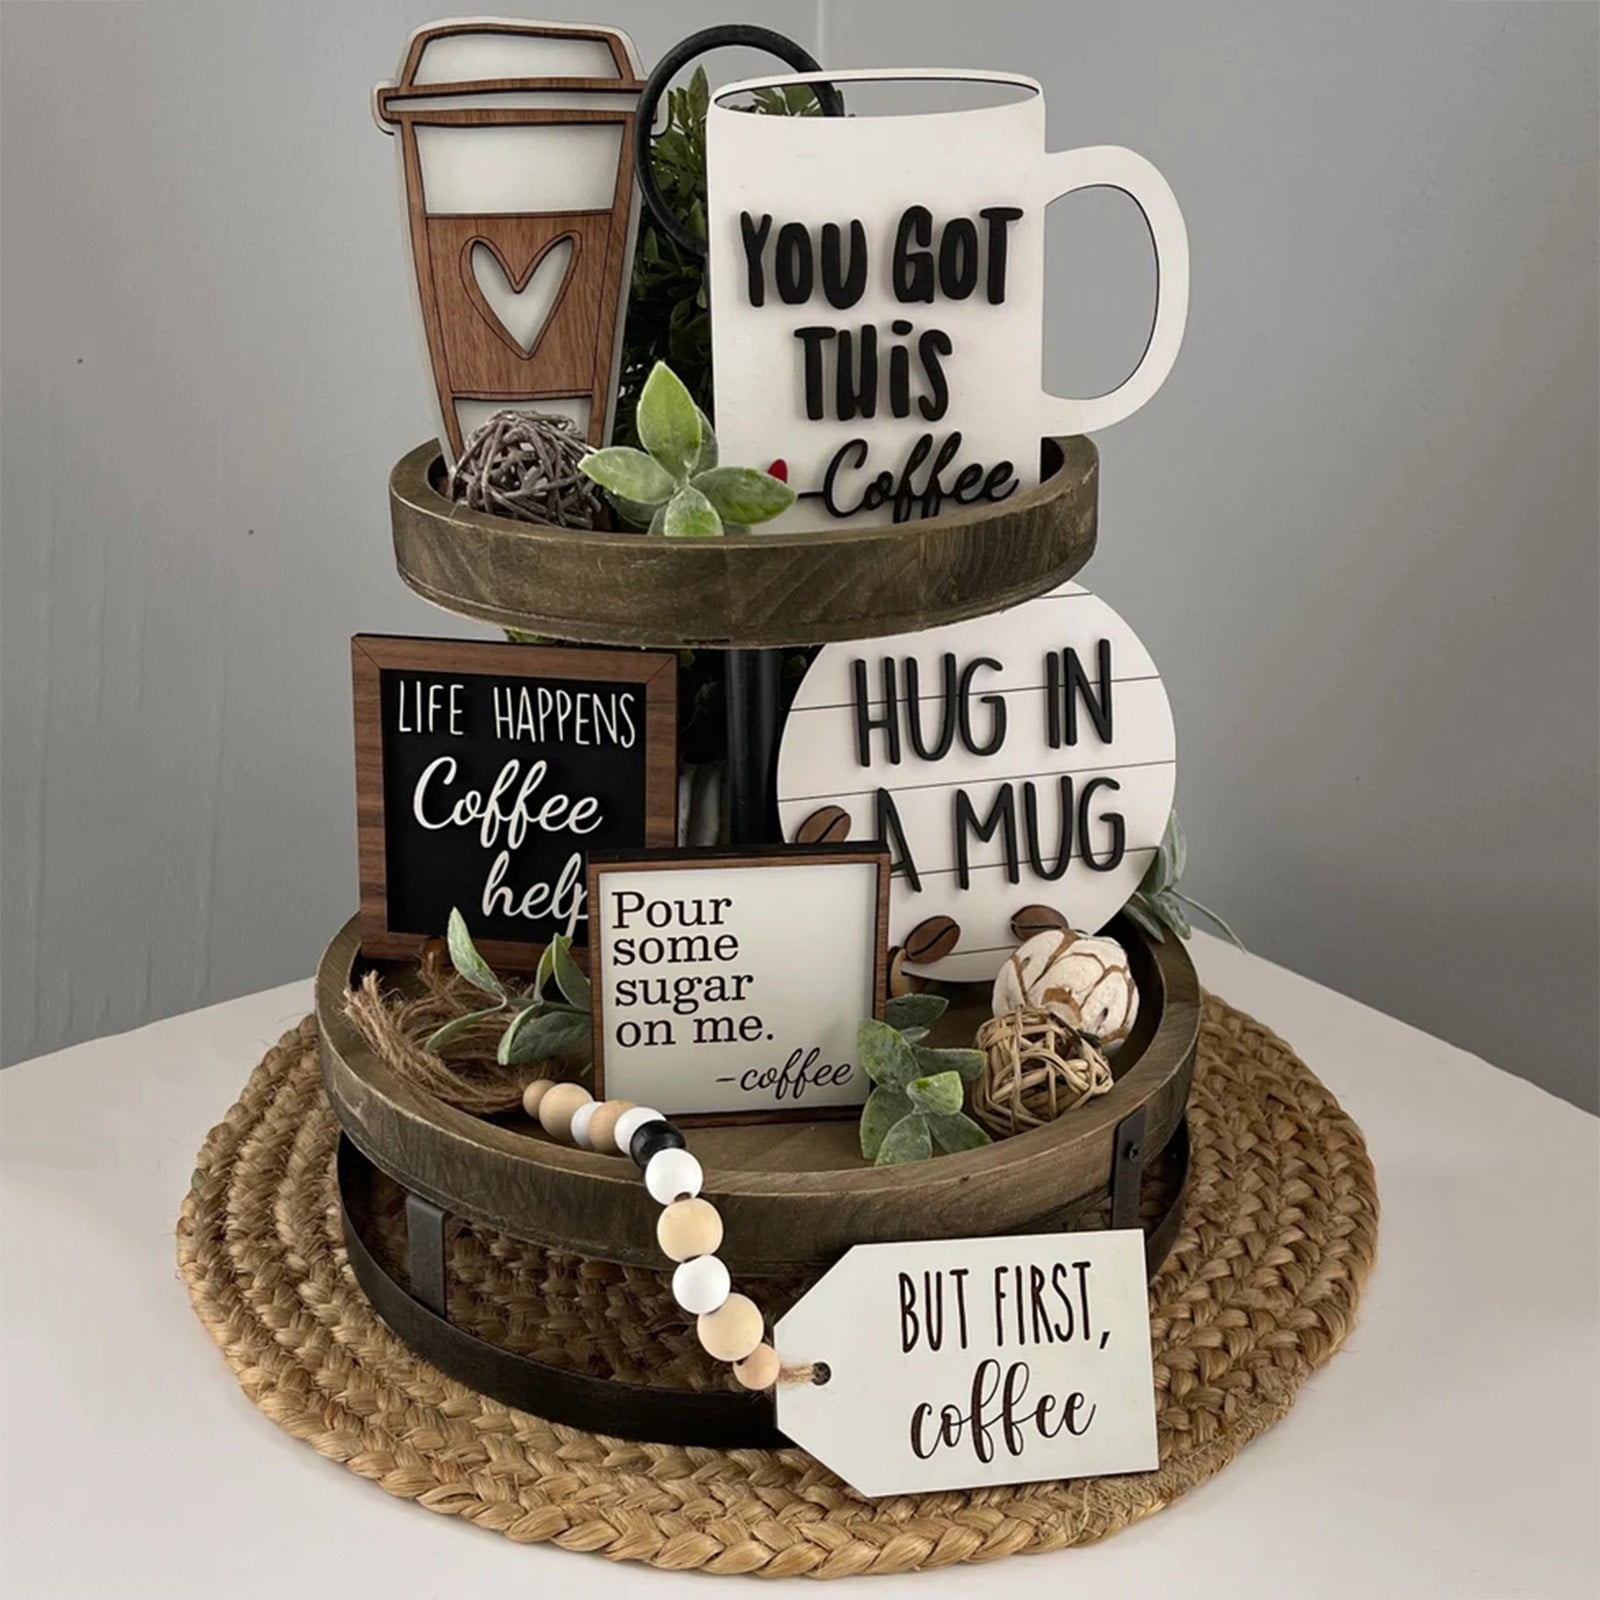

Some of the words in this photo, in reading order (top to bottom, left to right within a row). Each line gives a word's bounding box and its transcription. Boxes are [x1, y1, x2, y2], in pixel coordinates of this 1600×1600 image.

[740, 210, 868, 310] YOU
[892, 204, 1024, 304] GOT
[398, 680, 465, 735] LIFE
[493, 685, 636, 749] HAPPENS
[853, 652, 1008, 768] HUG
[1046, 638, 1113, 750] IN
[412, 756, 604, 850] Coffee
[876, 787, 922, 893] A
[955, 775, 1126, 891] MUG
[611, 890, 733, 930] Pour
[612, 932, 739, 967] some
[614, 973, 754, 1015] sugar
[615, 1017, 677, 1048] on
[692, 1014, 775, 1044] me.
[897, 1267, 969, 1354] BUT
[994, 1261, 1111, 1350] FIRST,
[910, 1358, 1097, 1464] coffee
